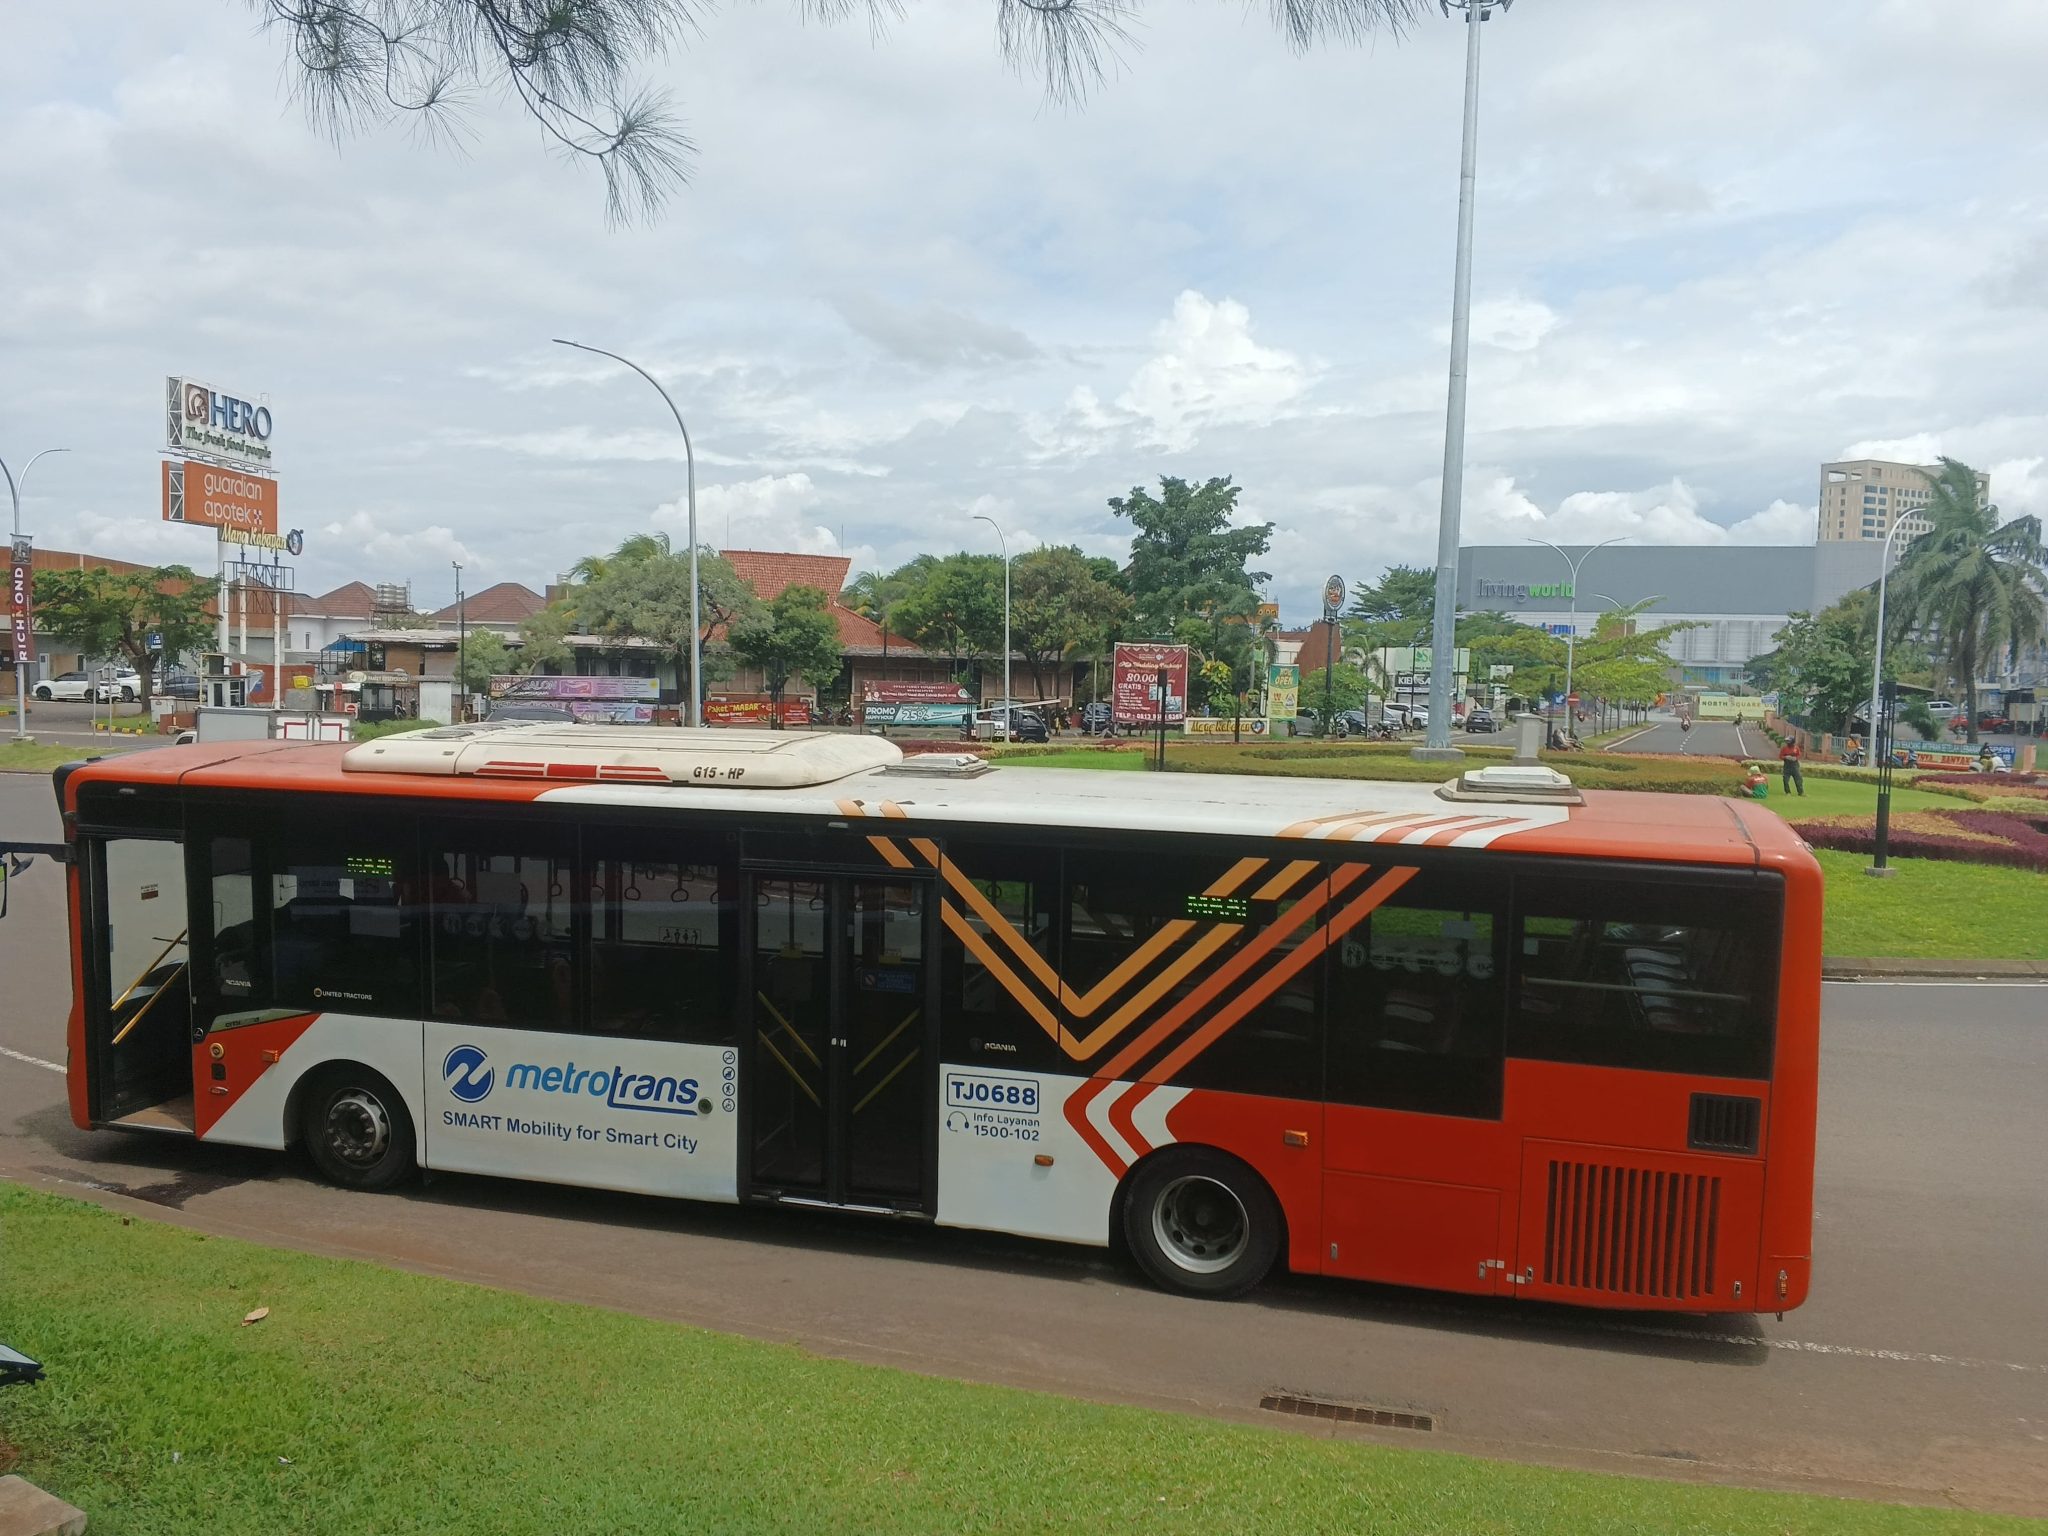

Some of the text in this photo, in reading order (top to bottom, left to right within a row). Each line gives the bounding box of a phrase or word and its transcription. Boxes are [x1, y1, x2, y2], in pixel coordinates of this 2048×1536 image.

[210, 391, 272, 440] HERO
[186, 426, 272, 461] The fresh food people
[204, 472, 262, 501] guardian
[204, 500, 252, 525] apotek
[1478, 578, 1573, 604] living world
[13, 567, 28, 660] RICHMOND
[1118, 682, 1142, 690] GRATIS
[1126, 672, 1159, 683] 80.00
[865, 706, 896, 715] PROMO
[903, 709, 929, 720] 25%
[1115, 711, 1131, 719] TELP
[693, 766, 718, 779] G15
[728, 767, 746, 780] HP
[322, 989, 373, 1001] UNITED TRACTORS
[984, 1042, 1017, 1052] SCANIA
[505, 1062, 699, 1115] metrotrans
[951, 1081, 1036, 1106] TJ0688
[973, 1112, 1040, 1128] Info Layanan
[442, 1110, 698, 1154] SMART Mobility for Smart City
[974, 1124, 1040, 1142] 1500-102
